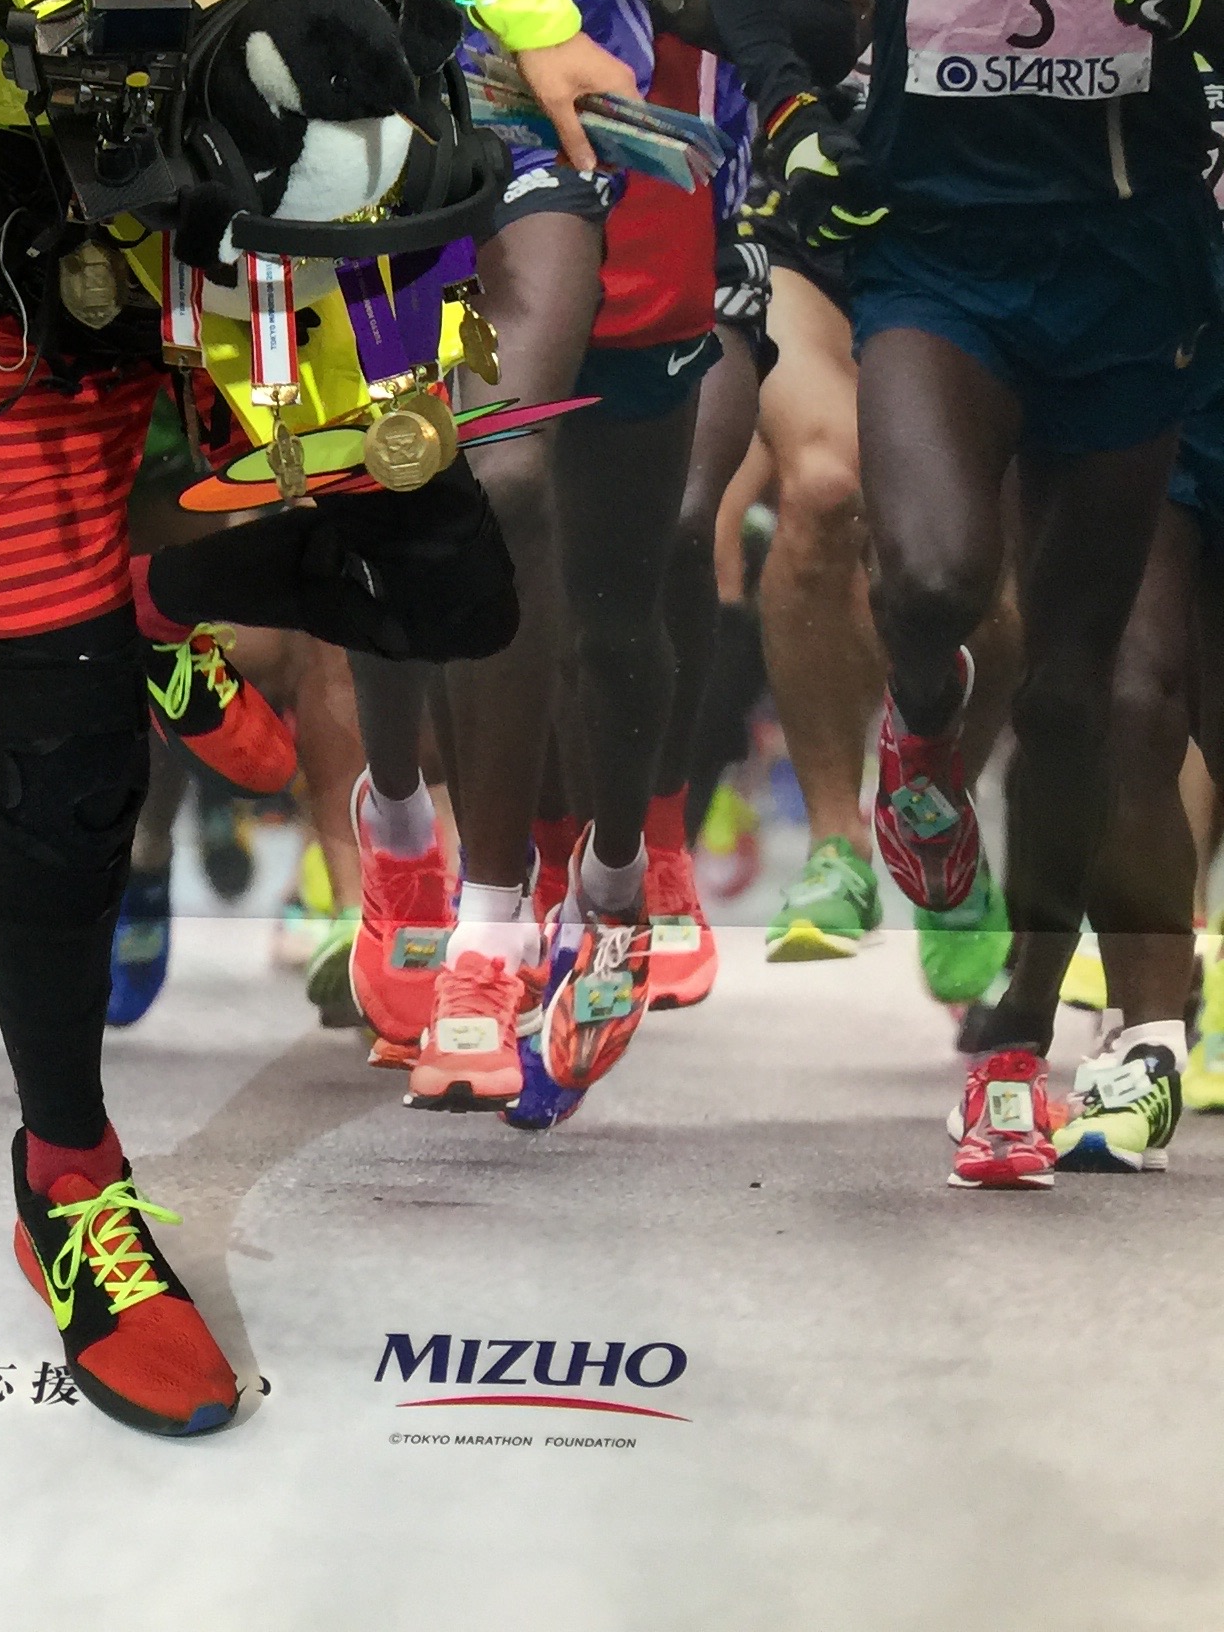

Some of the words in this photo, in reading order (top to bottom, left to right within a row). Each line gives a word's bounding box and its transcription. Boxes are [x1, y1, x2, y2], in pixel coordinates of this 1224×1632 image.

[982, 55, 1121, 97] STARTS
[373, 1333, 688, 1388] MIZUHO
[454, 1435, 534, 1447] MARATHON
[545, 1437, 638, 1449] FOUNDATION
